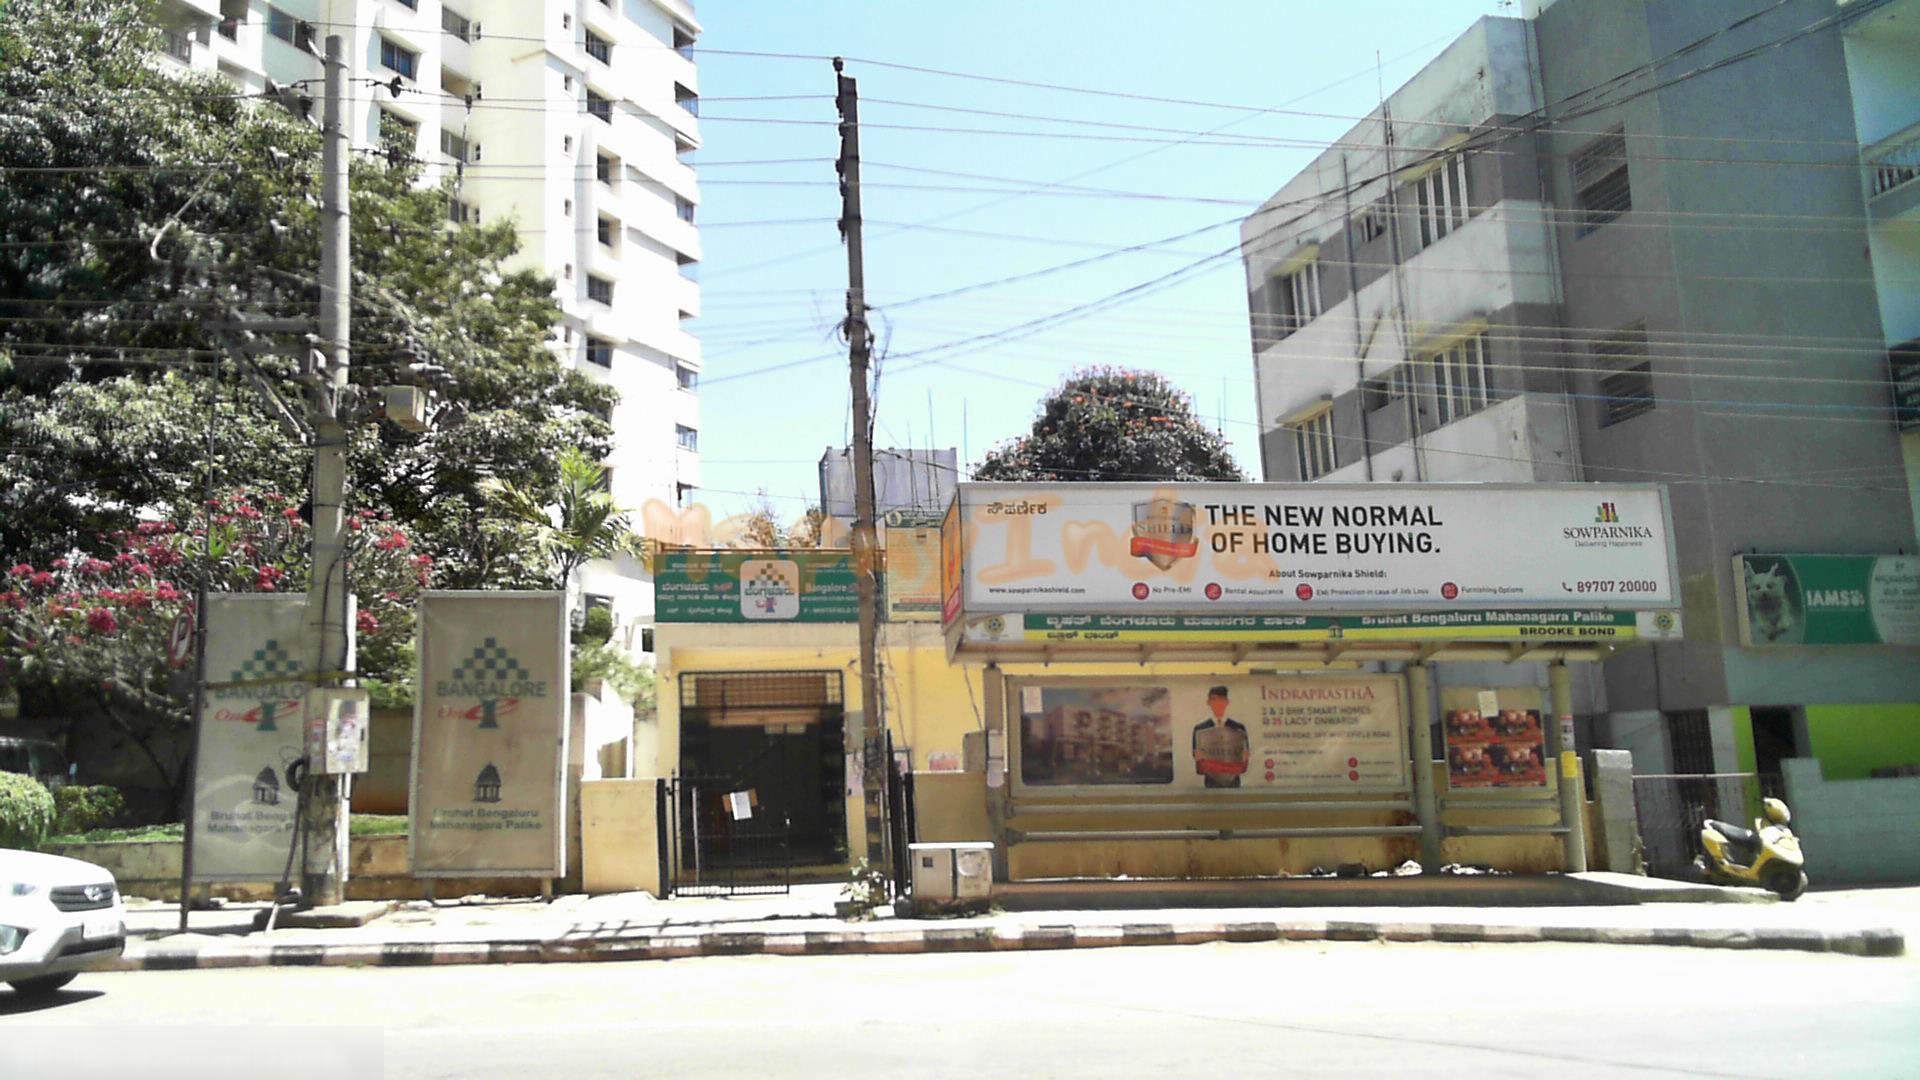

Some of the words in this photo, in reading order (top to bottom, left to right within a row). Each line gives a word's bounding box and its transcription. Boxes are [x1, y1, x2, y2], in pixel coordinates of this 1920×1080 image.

[1205, 505, 1256, 526] THE
[1264, 505, 1324, 527] NEW
[1333, 505, 1443, 527] NORMAL
[1563, 526, 1652, 539] SOWPARNIKA
[1211, 532, 1243, 553] OF
[1253, 532, 1327, 554] HOME
[1336, 532, 1440, 554] BUYING.
[1269, 569, 1296, 578] About
[1298, 569, 1352, 581] Sowparnika
[1355, 569, 1387, 578] Shield:
[1248, 588, 1284, 596] Assurance
[1461, 586, 1497, 594] Furnishing
[1498, 586, 1523, 594] Options
[1577, 581, 1615, 593] 89707
[1619, 581, 1657, 593] 20000
[1807, 589, 1851, 607] IAMS
[1362, 614, 1408, 625] Bruhat
[1412, 611, 1482, 625] Bengaluru
[1486, 611, 1569, 625] Mahanagara
[1573, 611, 1615, 622] Palike
[1520, 627, 1575, 636] BROOKE
[1579, 627, 1616, 636] BOND
[437, 680, 547, 697] BANGALORE
[1261, 685, 1375, 700] INDRAPRASTHA
[477, 808, 539, 819] Bengaluru
[506, 820, 543, 829] Palike
